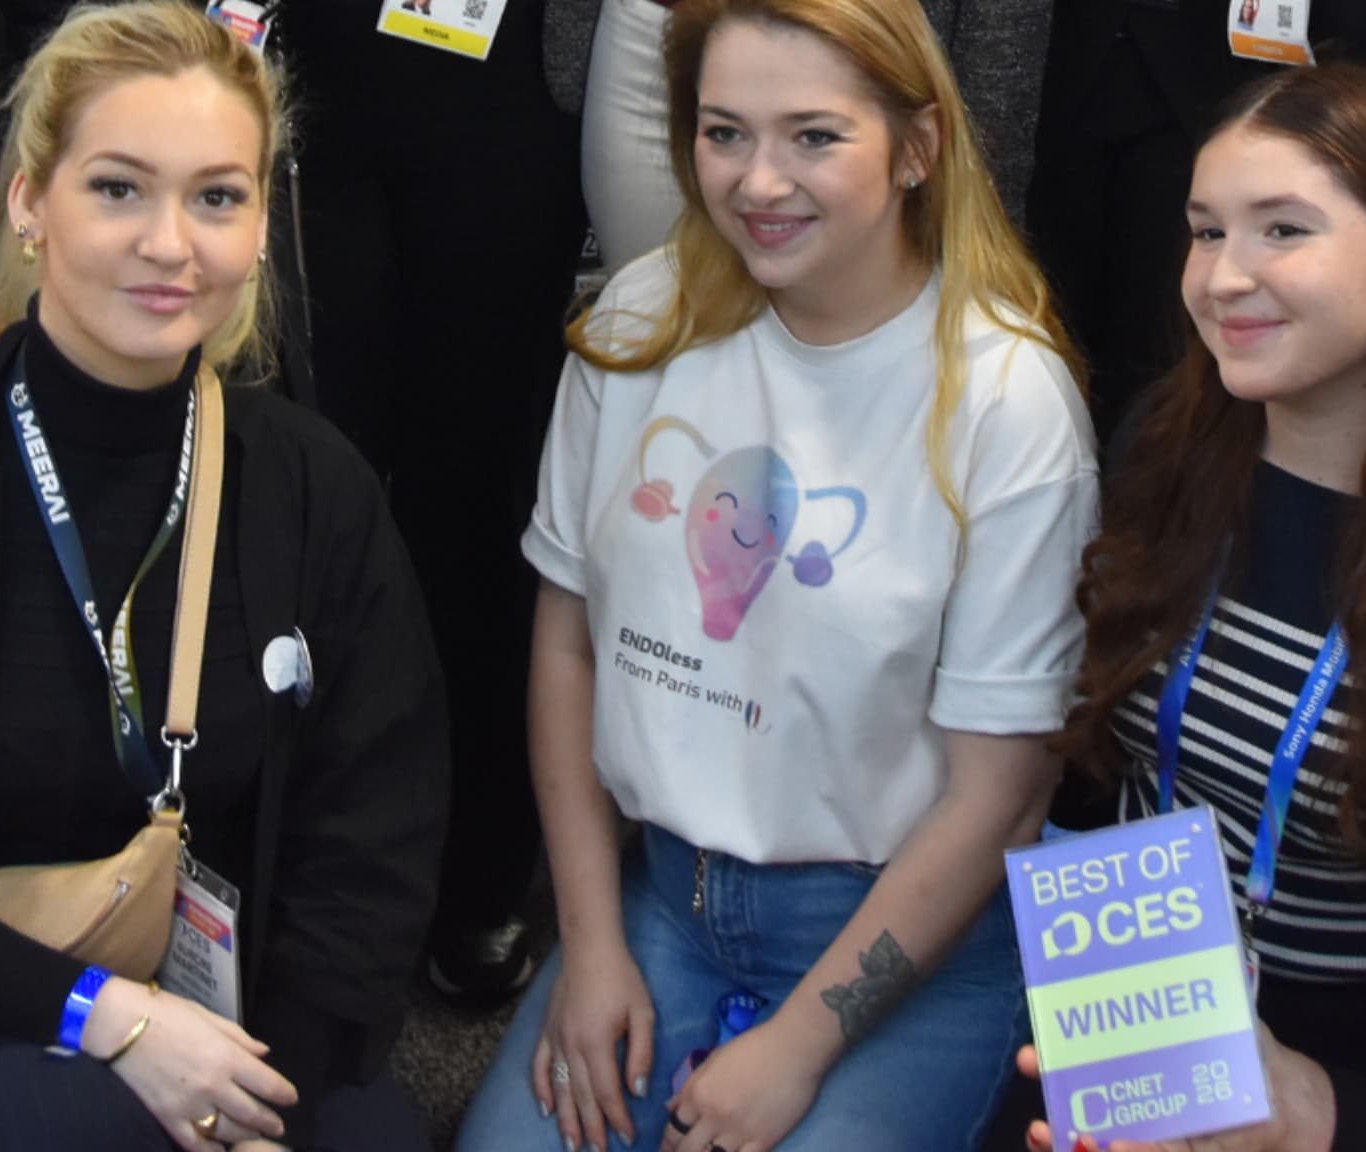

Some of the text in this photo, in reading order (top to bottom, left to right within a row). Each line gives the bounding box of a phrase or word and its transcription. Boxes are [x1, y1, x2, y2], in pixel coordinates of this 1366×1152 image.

[17, 408, 70, 524] MEERAI
[618, 626, 704, 672] ENDOless
[614, 651, 744, 713] From Paris with
[1282, 723, 1311, 760] Sony
[1298, 680, 1329, 726] Honda
[1030, 838, 1192, 906] BEST OF
[1097, 886, 1204, 947] CES
[1054, 977, 1219, 1041] WINNER
[1110, 1073, 1165, 1104] CNET
[1114, 1093, 1188, 1127] GROUP
